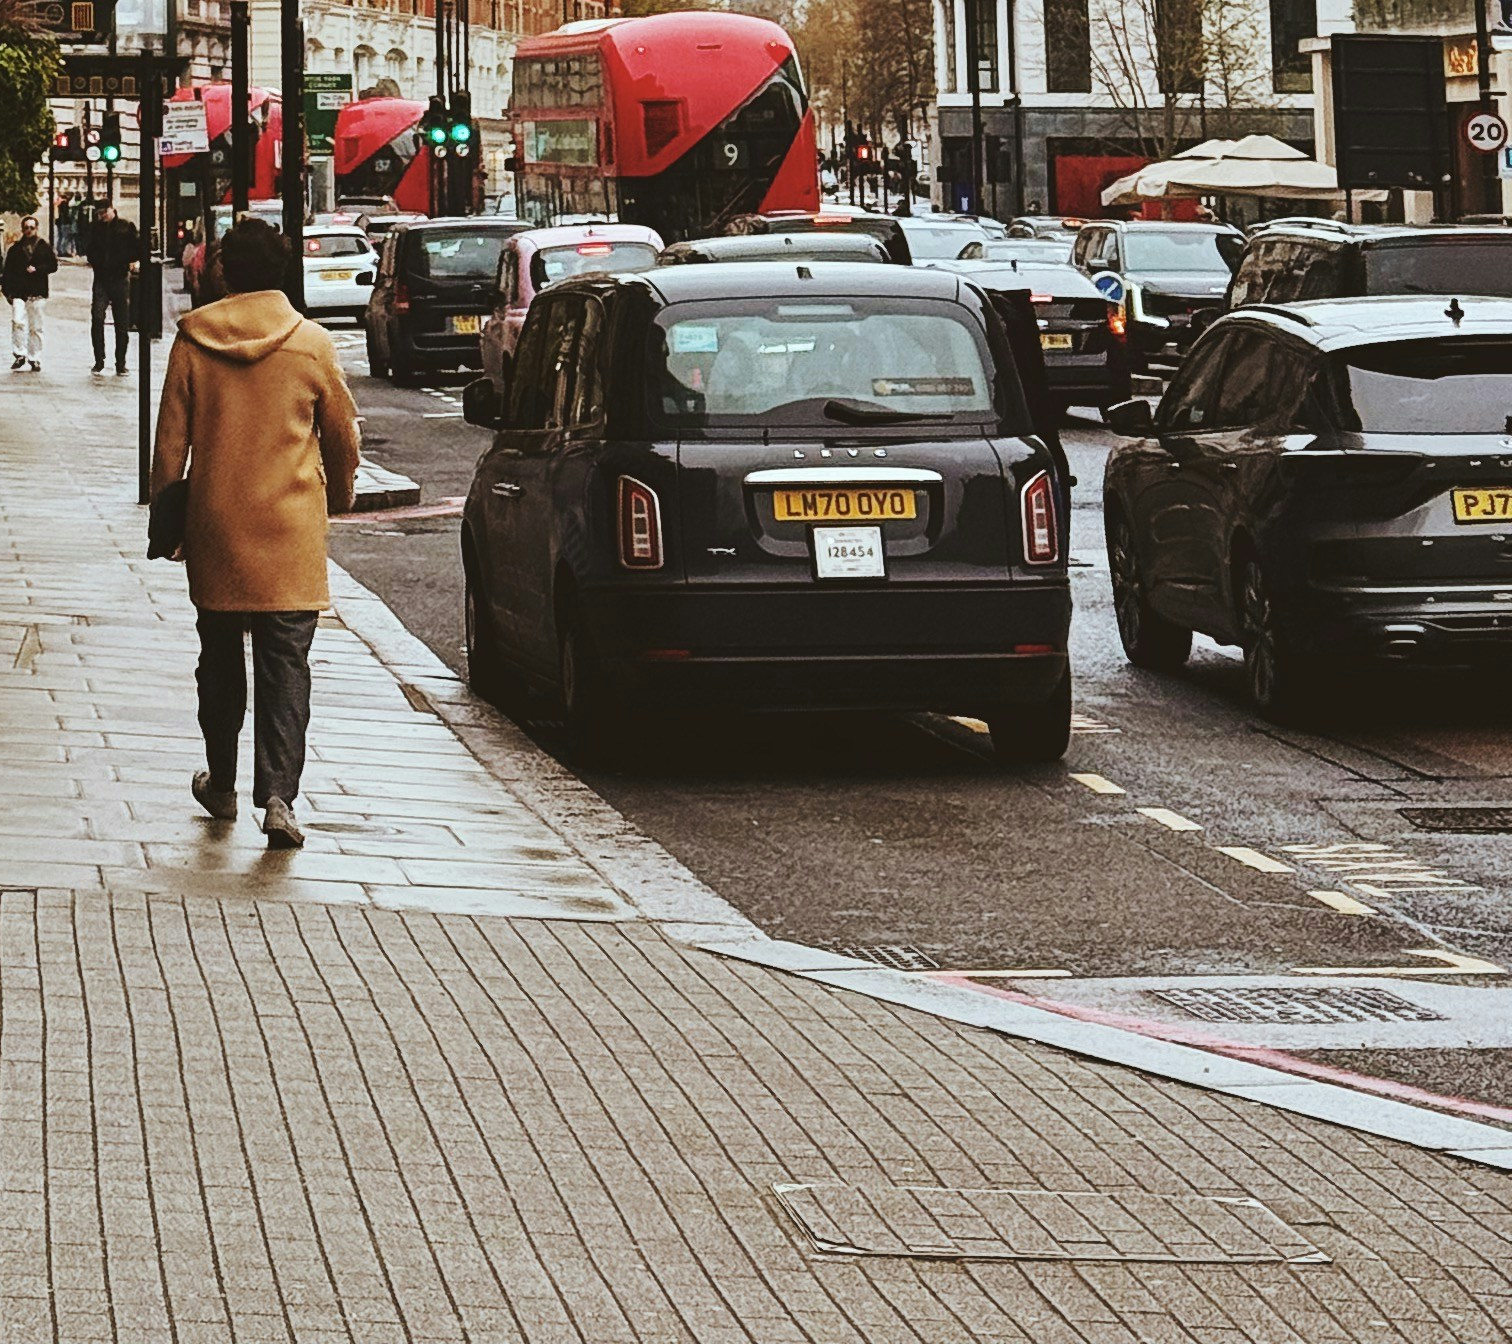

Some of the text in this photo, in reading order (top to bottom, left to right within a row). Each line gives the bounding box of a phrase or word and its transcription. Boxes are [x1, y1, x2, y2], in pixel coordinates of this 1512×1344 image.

[1470, 123, 1502, 141] 20
[723, 143, 738, 166] 9
[793, 448, 887, 458] LEVC
[785, 492, 906, 517] LM70 OYO
[827, 545, 874, 558] 128454
[1279, 843, 1484, 899] TAXIS
